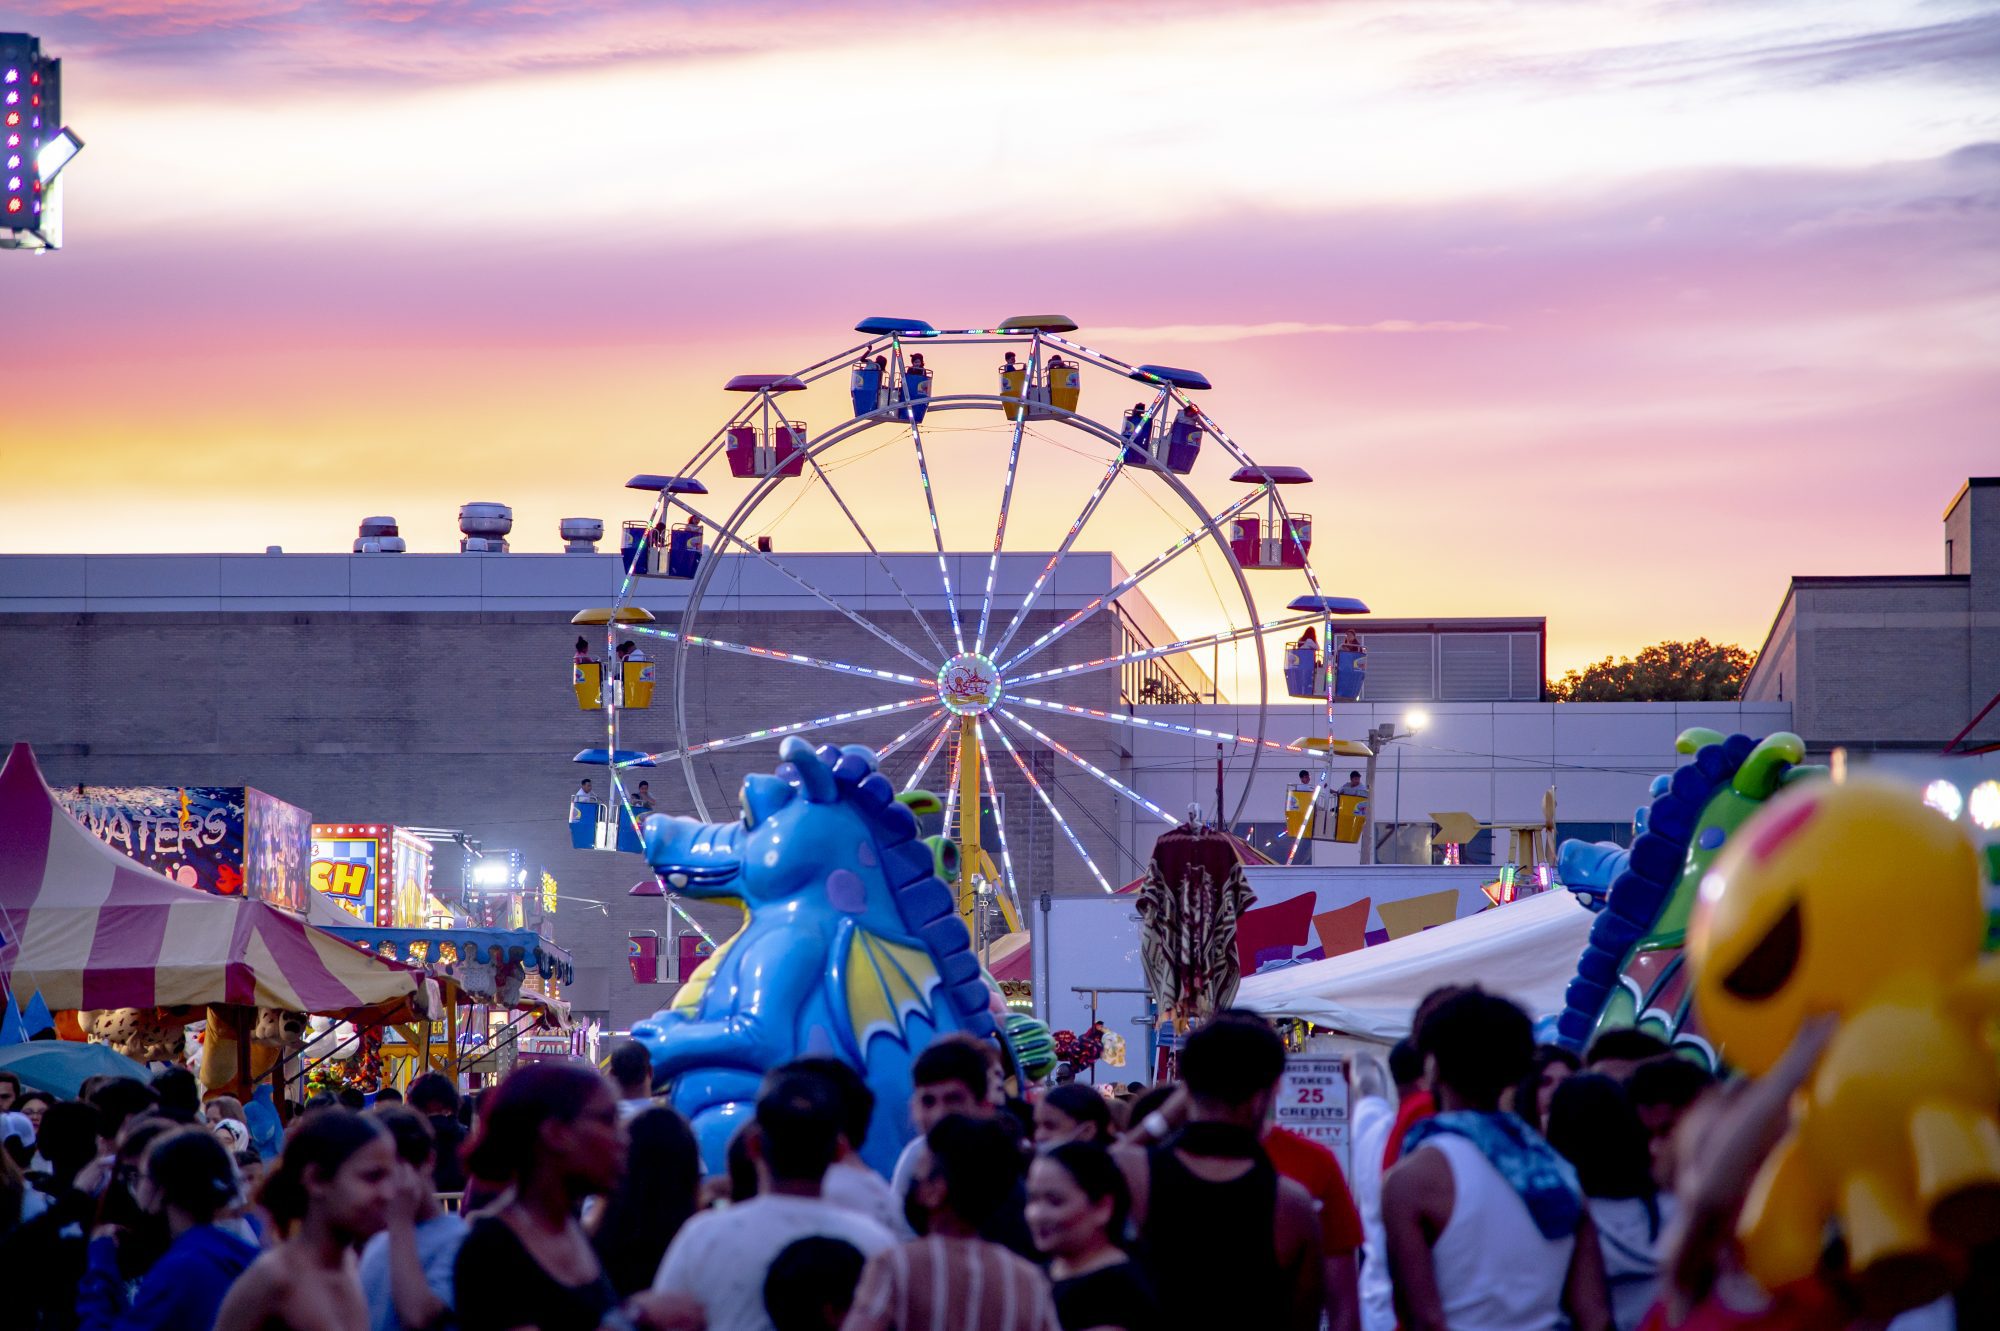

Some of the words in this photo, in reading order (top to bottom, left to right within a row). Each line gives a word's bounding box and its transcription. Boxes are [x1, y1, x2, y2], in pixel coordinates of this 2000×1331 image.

[78, 807, 227, 854] WATERS
[1290, 1076, 1333, 1085] TAKES
[1297, 1088, 1324, 1104] 25
[1279, 1107, 1344, 1118] CREDITS
